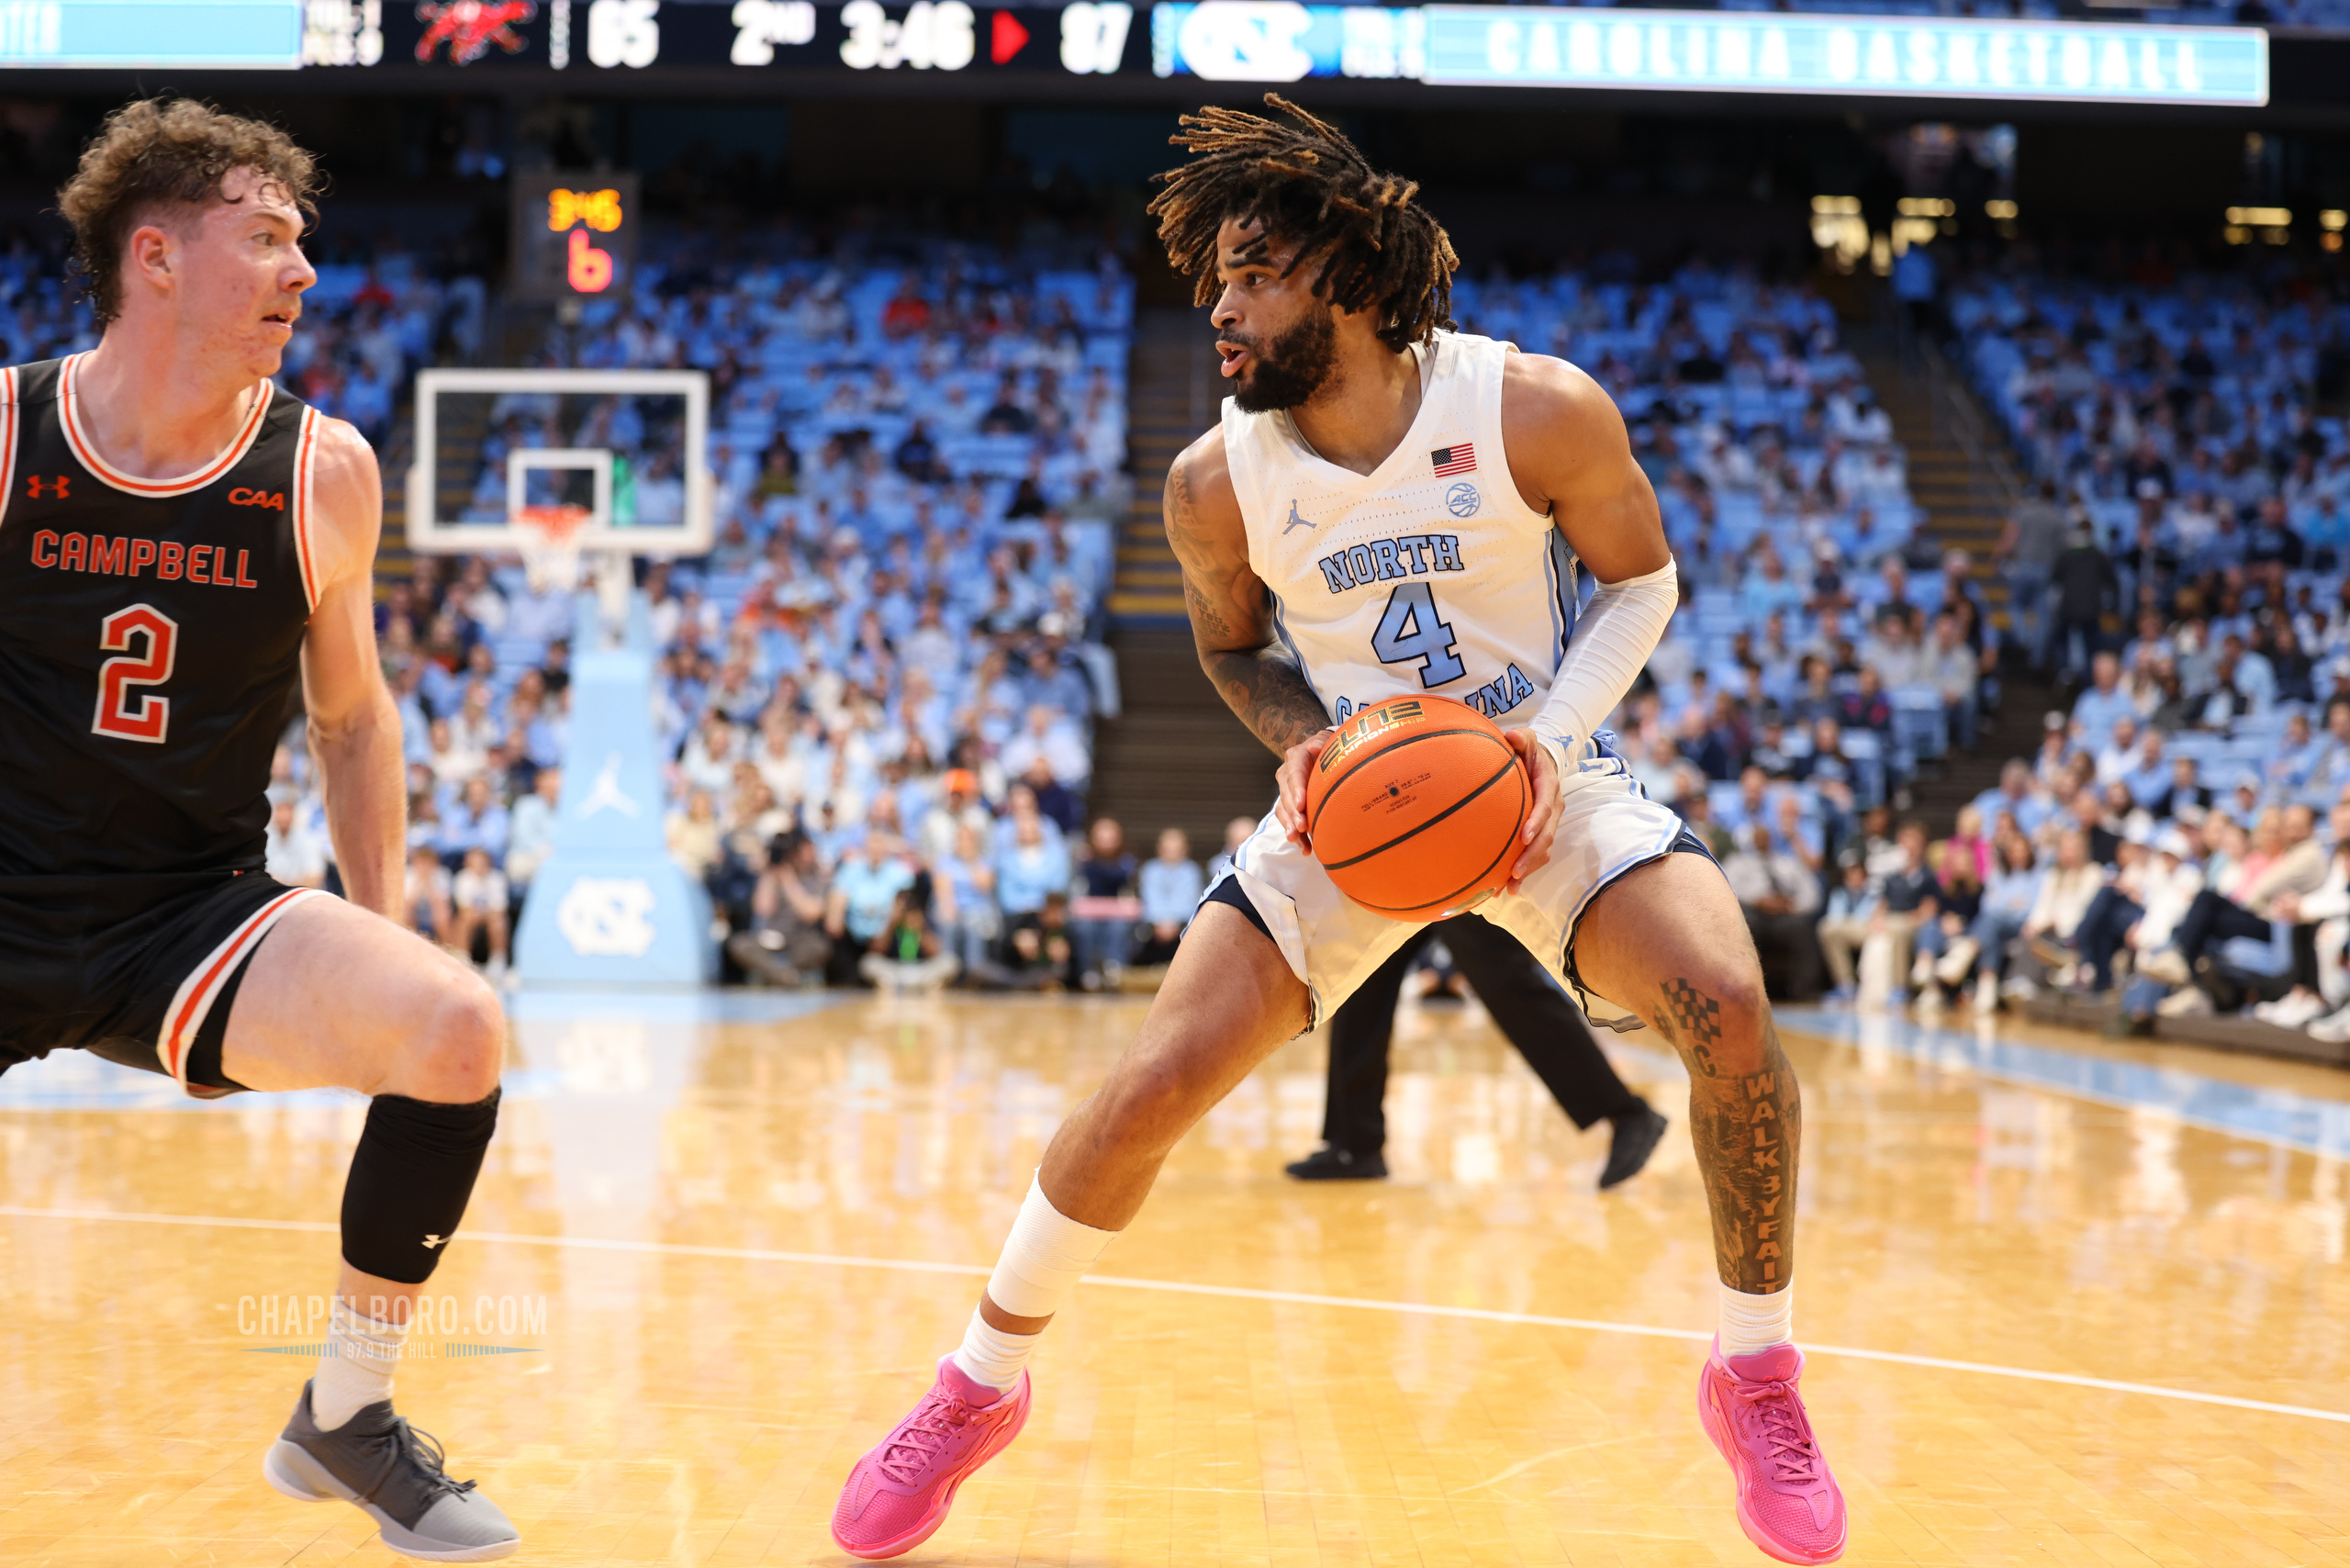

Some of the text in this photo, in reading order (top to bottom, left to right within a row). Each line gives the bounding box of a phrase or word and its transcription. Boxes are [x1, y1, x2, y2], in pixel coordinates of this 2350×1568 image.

[588, 0, 659, 68] 65
[1487, 18, 1791, 80] CAROLINA
[1828, 26, 2203, 92] BASKETBALL
[228, 487, 284, 510] CAA
[31, 529, 257, 588] CAMPBELL
[1318, 534, 1465, 594] NORTH
[1371, 581, 1467, 689] 4
[91, 603, 178, 744] 2
[1336, 662, 1535, 727] CINA
[1319, 700, 1425, 774] ELITE
